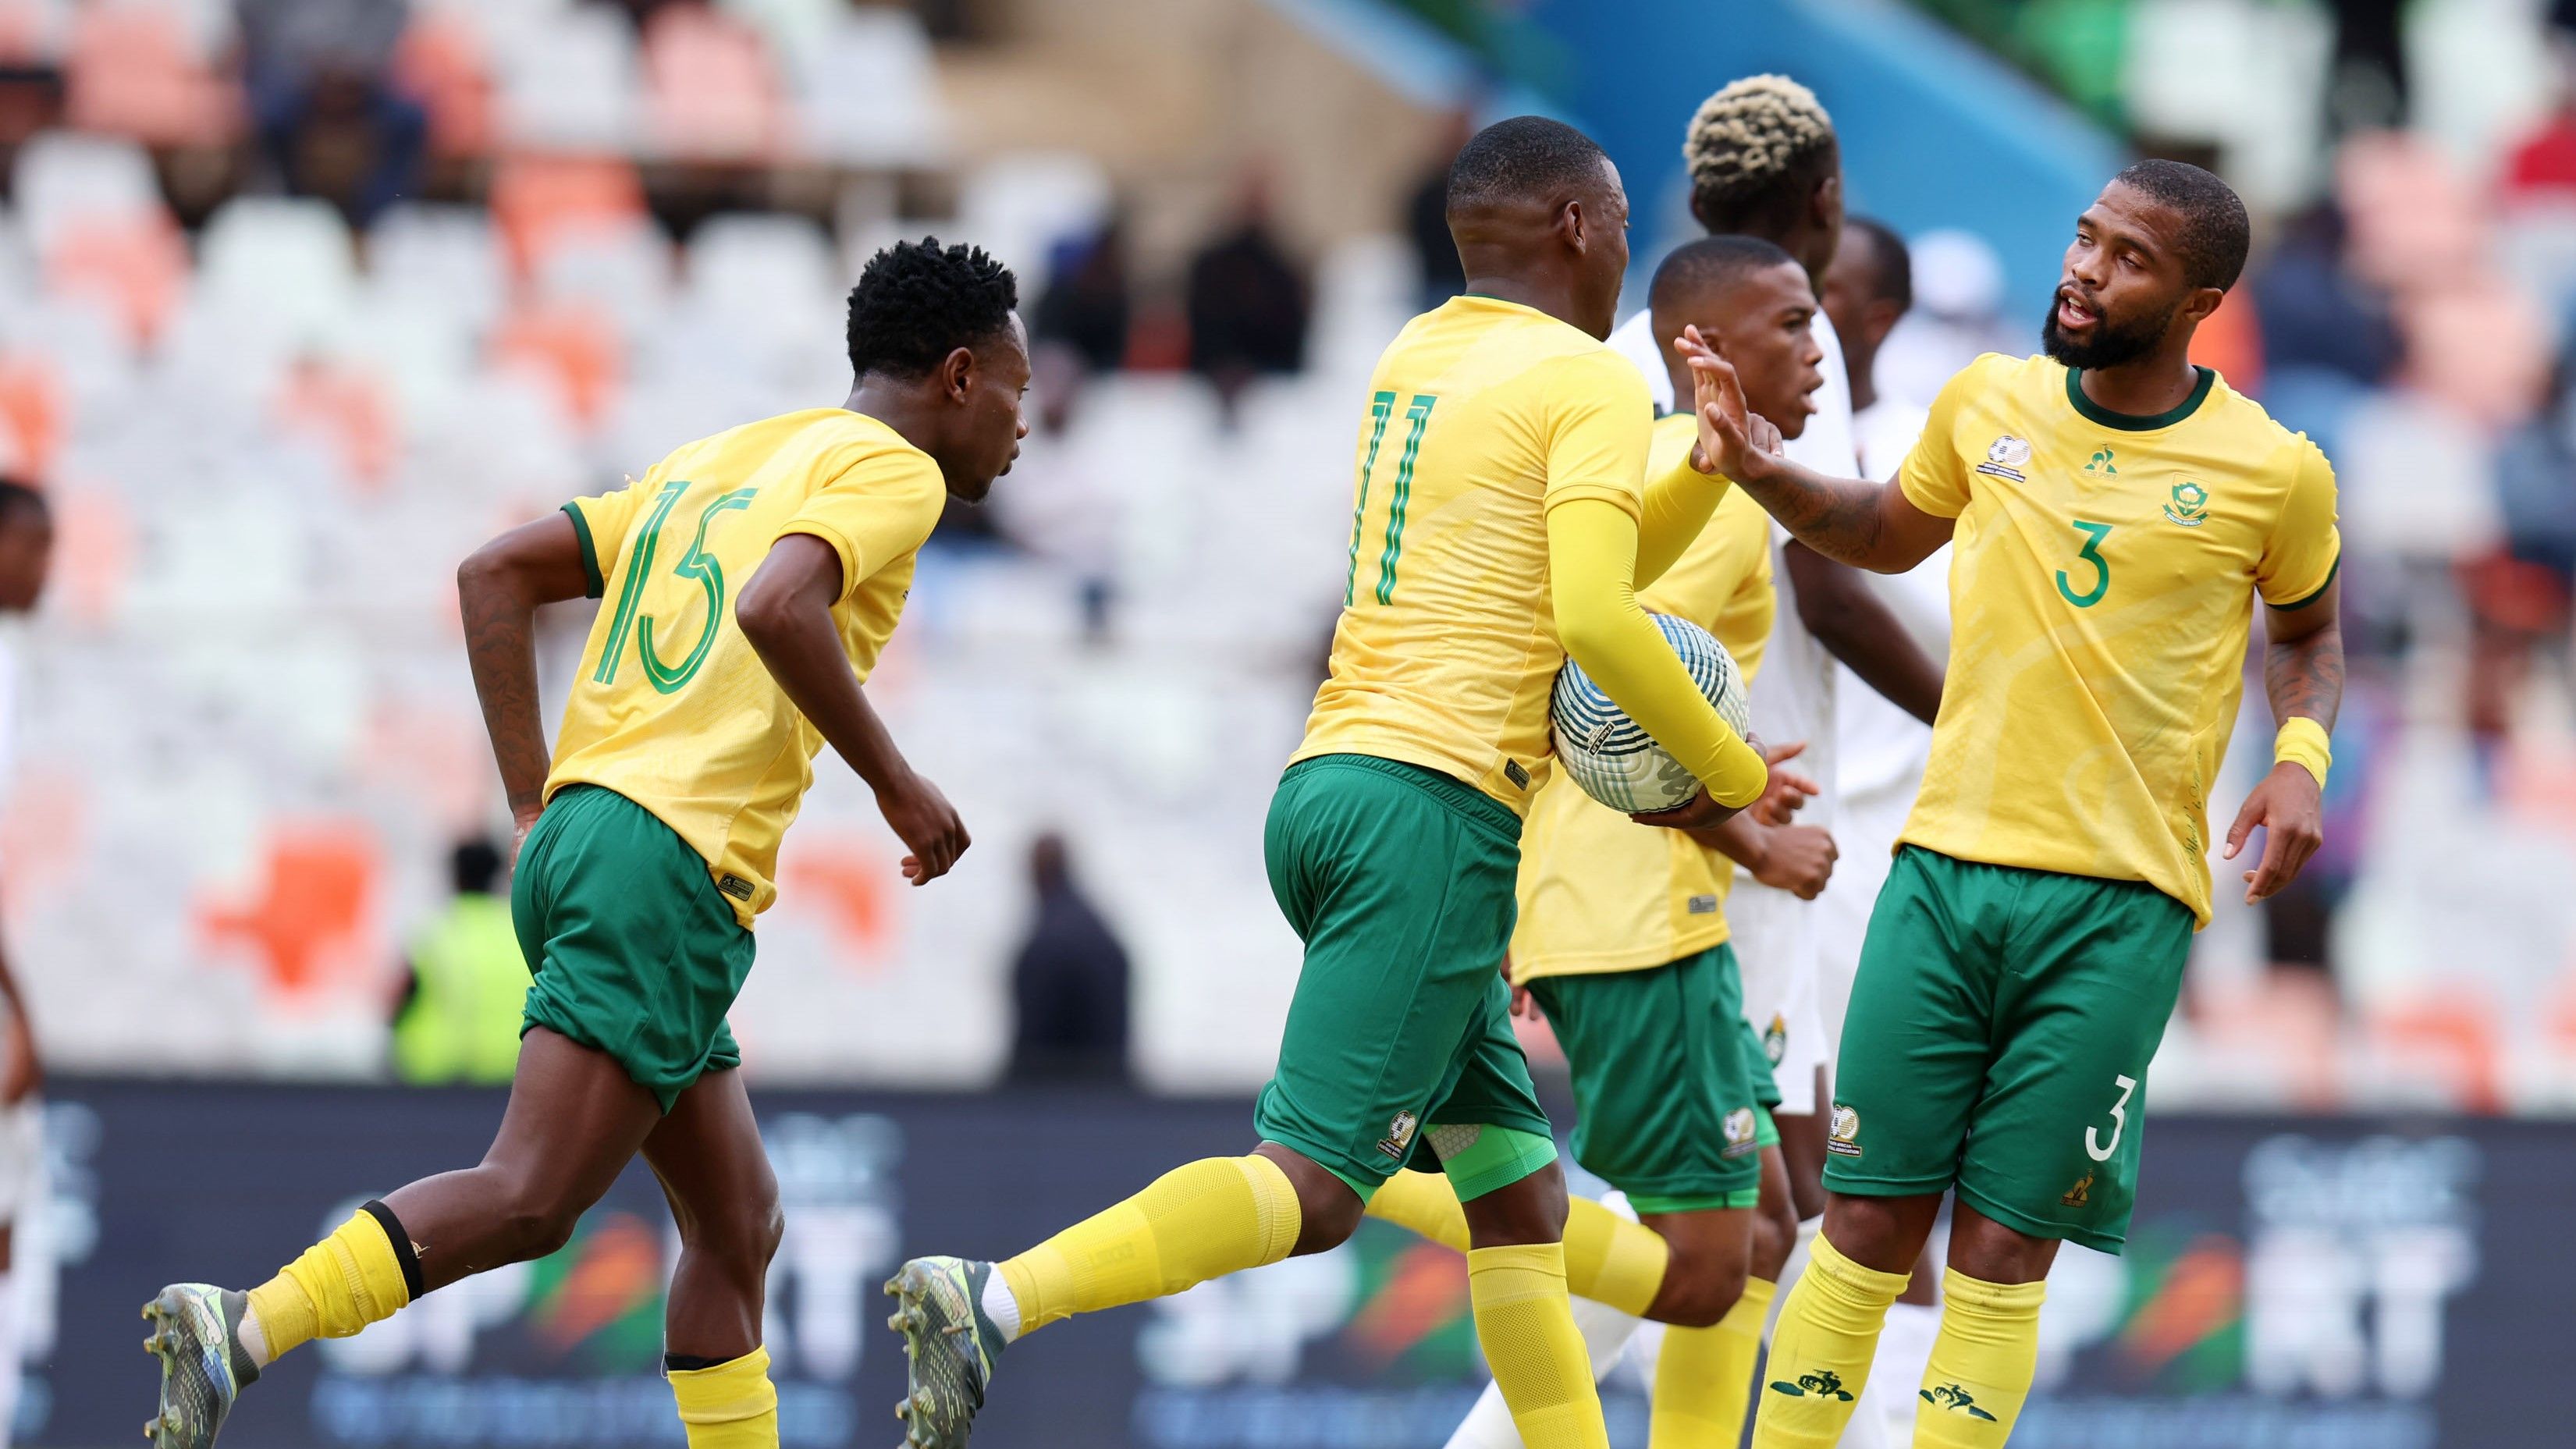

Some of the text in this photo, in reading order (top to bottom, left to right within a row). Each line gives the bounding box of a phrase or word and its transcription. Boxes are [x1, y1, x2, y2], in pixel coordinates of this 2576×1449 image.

[1343, 391, 1437, 606] 11
[2055, 519, 2114, 609] 3
[593, 481, 759, 695] 15
[2084, 1074, 2137, 1162] 3
